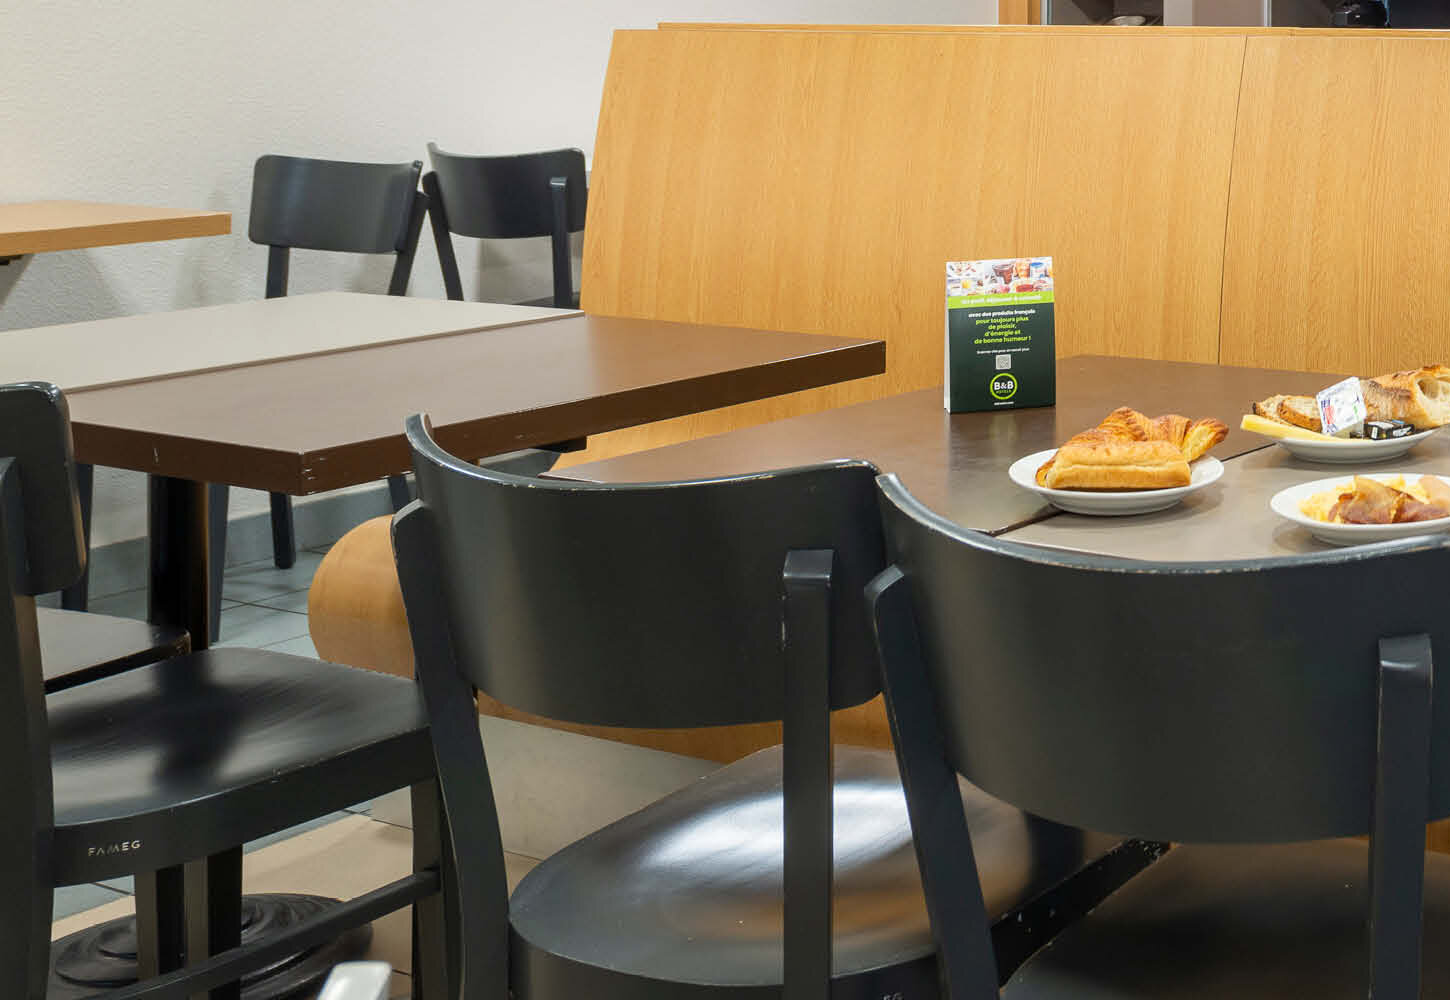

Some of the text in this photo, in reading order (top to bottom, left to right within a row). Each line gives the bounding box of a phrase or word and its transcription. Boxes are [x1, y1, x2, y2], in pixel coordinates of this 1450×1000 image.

[991, 316, 1016, 325] toujours
[984, 329, 1014, 338] d'énergie
[1003, 335, 1028, 343] humeur
[993, 381, 1014, 390] B&B
[87, 840, 141, 857] FAMEG
